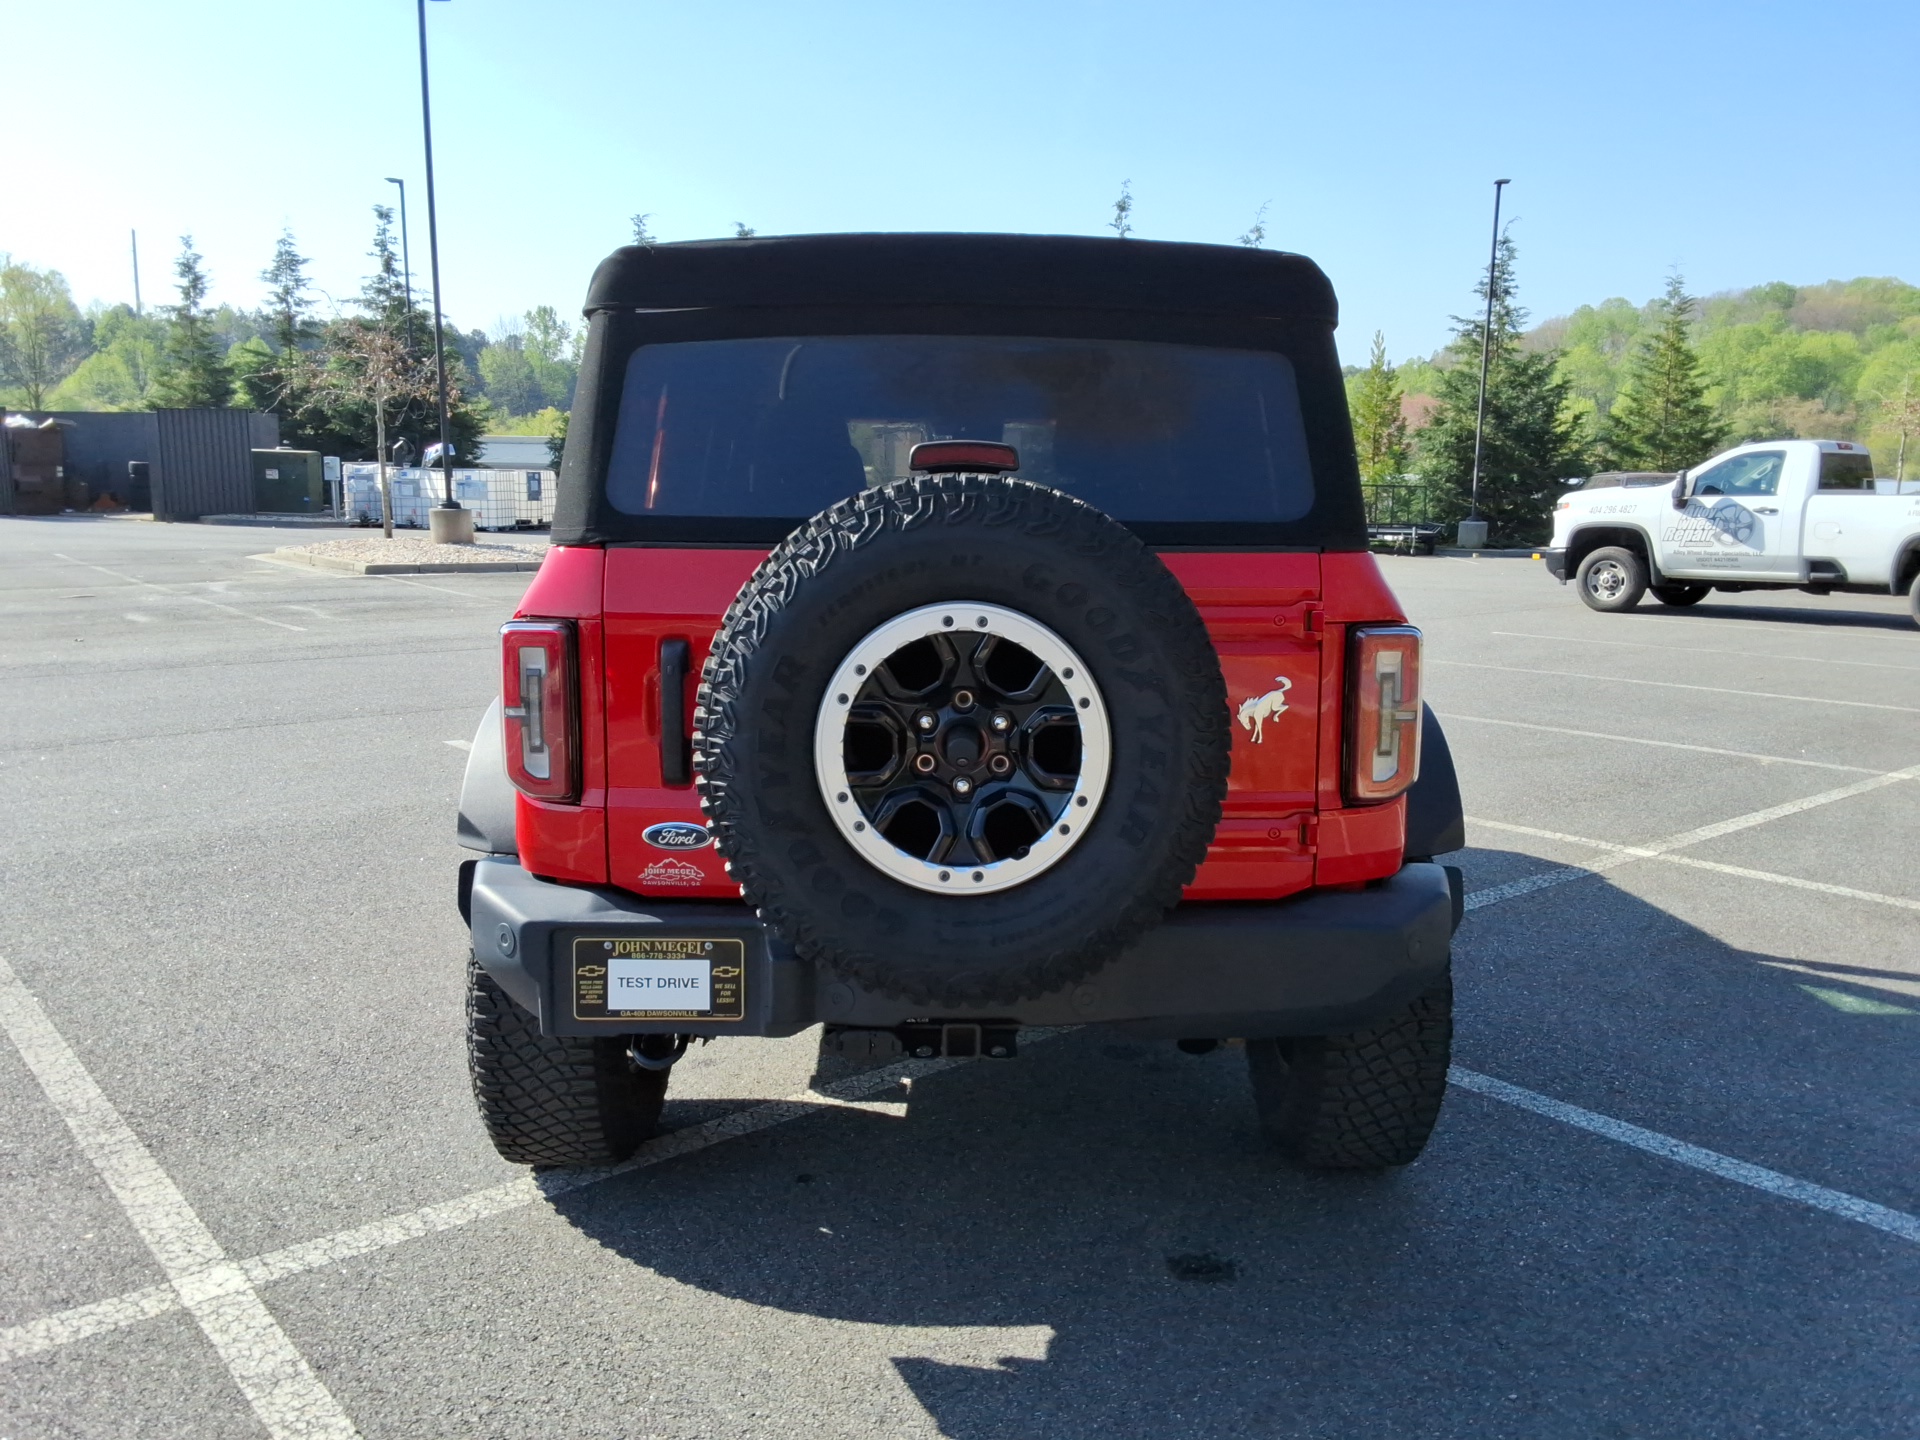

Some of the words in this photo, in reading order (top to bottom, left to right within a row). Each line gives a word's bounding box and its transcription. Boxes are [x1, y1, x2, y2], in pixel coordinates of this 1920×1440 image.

[1685, 504, 1718, 519] Alloy
[1677, 516, 1721, 530] Wheel
[1662, 527, 1716, 547] Repair
[658, 828, 697, 845] Ford
[644, 868, 666, 876] JOHN
[667, 868, 697, 876] MEGEL
[613, 941, 651, 956] JOHN
[654, 941, 706, 956] MEGEL
[617, 977, 652, 988] TEST
[657, 977, 700, 989] DRIVE
